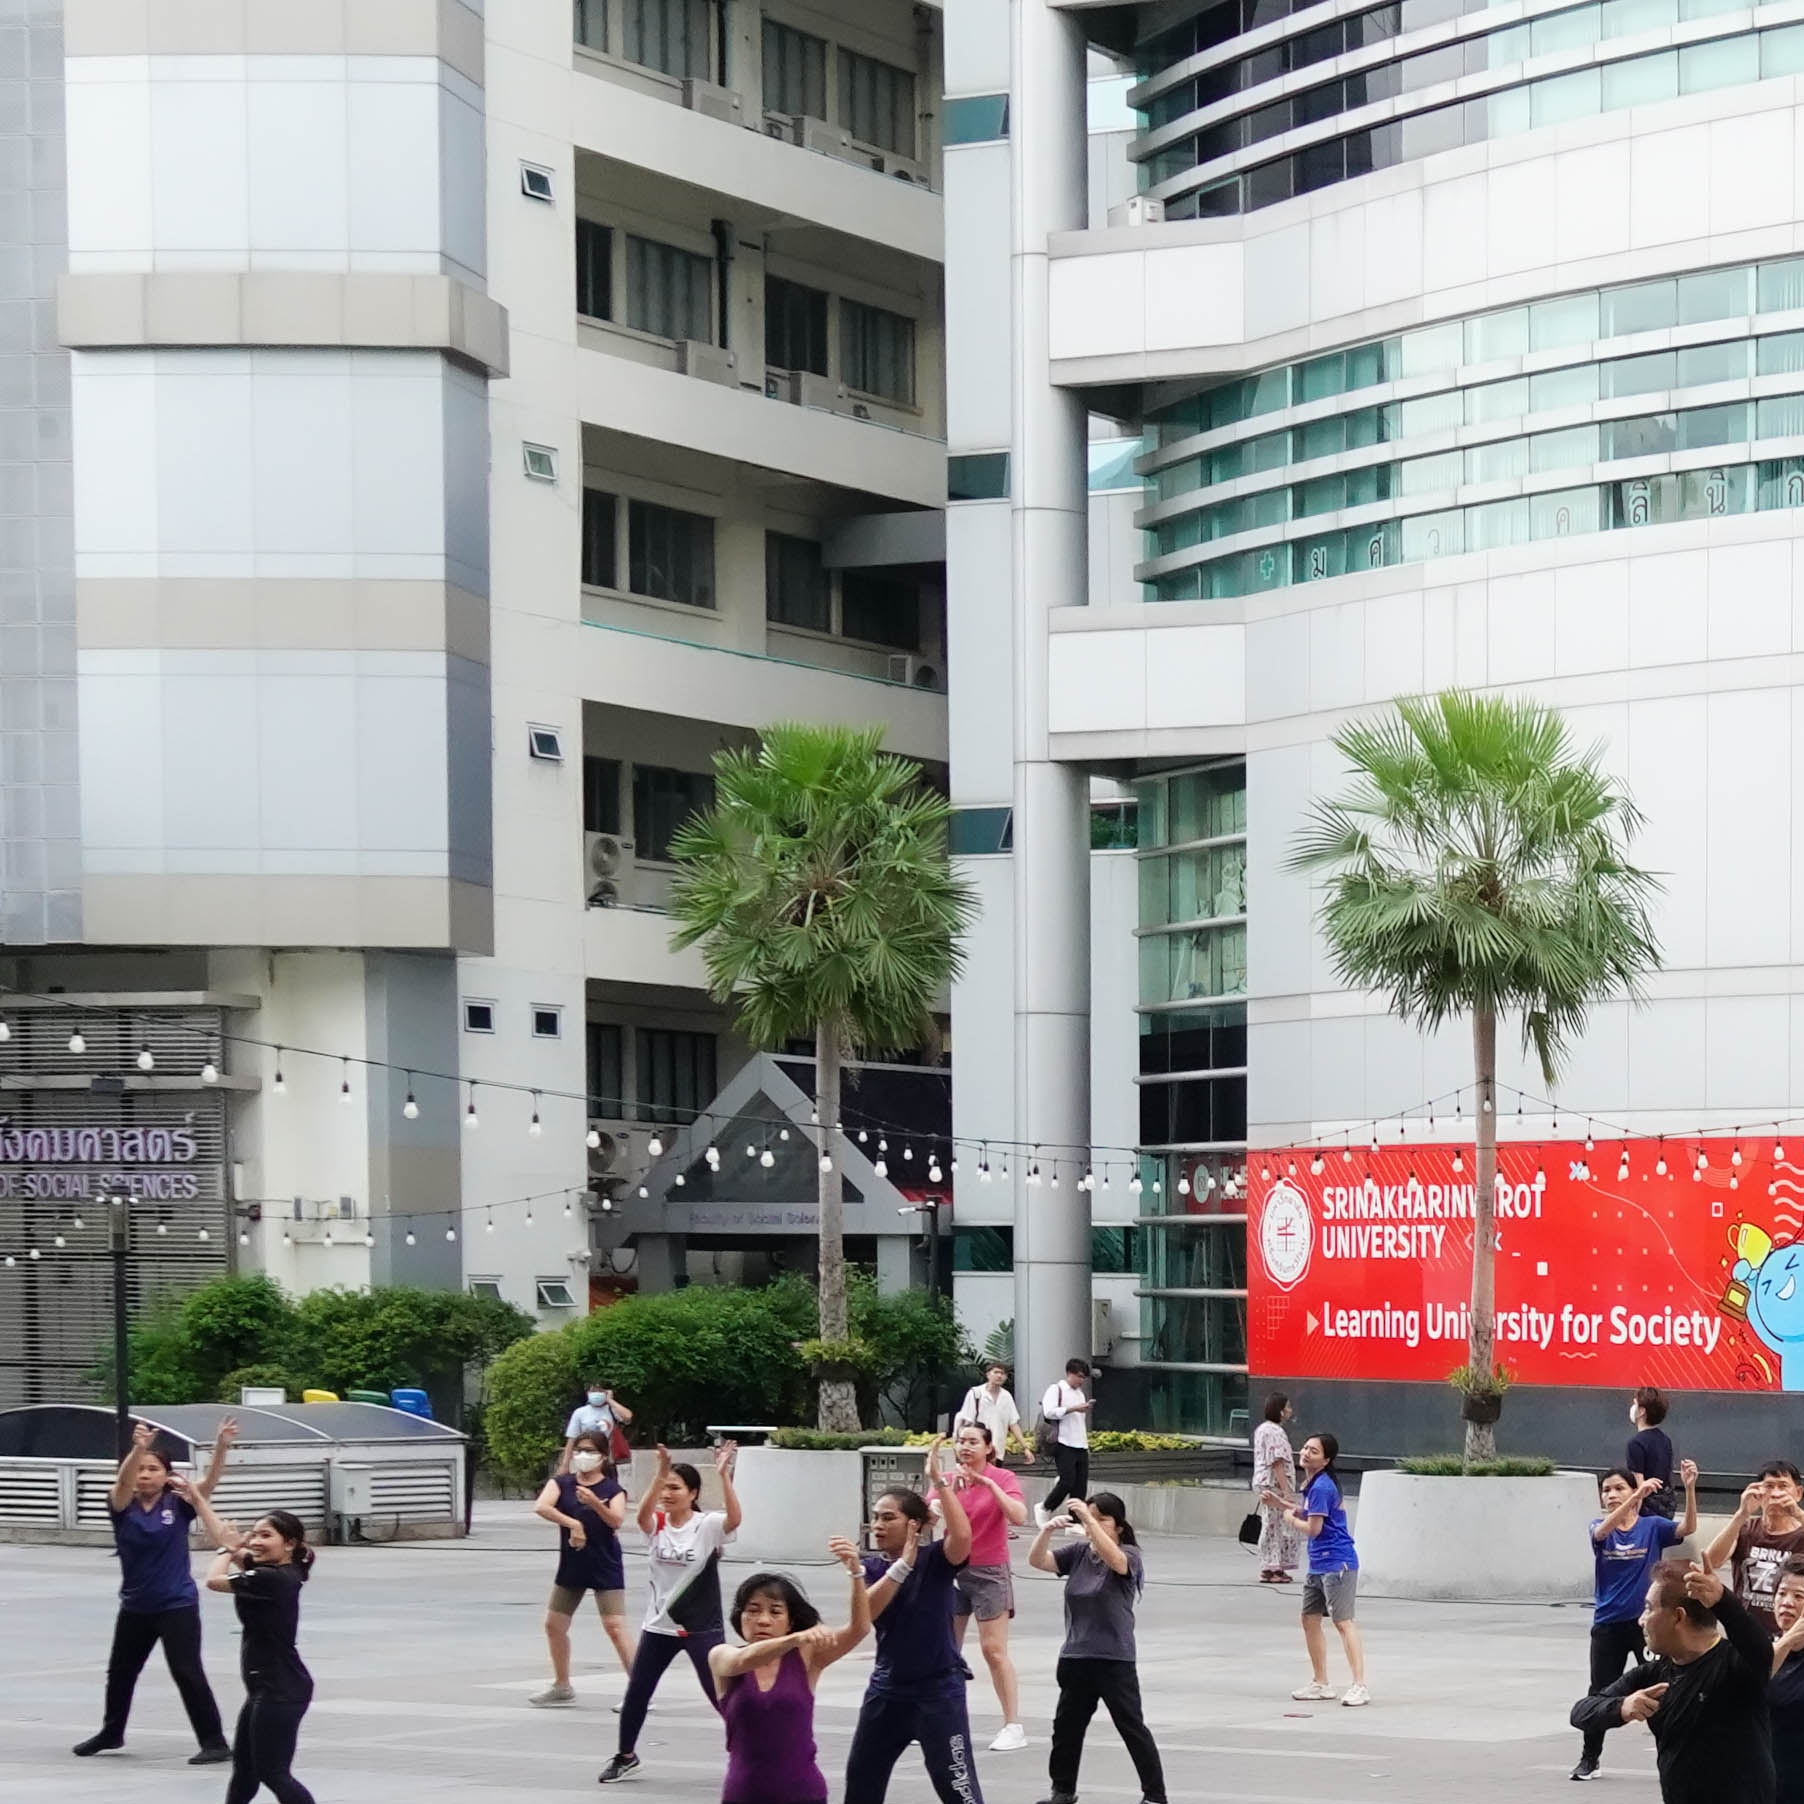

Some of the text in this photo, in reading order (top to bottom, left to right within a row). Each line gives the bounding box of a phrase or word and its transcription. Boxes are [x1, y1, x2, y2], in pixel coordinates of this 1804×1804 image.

[0, 1112, 198, 1162] ังคมศาสตร์
[25, 1174, 92, 1198] SOCIAL
[1322, 1225, 1447, 1259] UNIVERSITY
[1324, 1301, 1721, 1355] Learning Unirsity for Society
